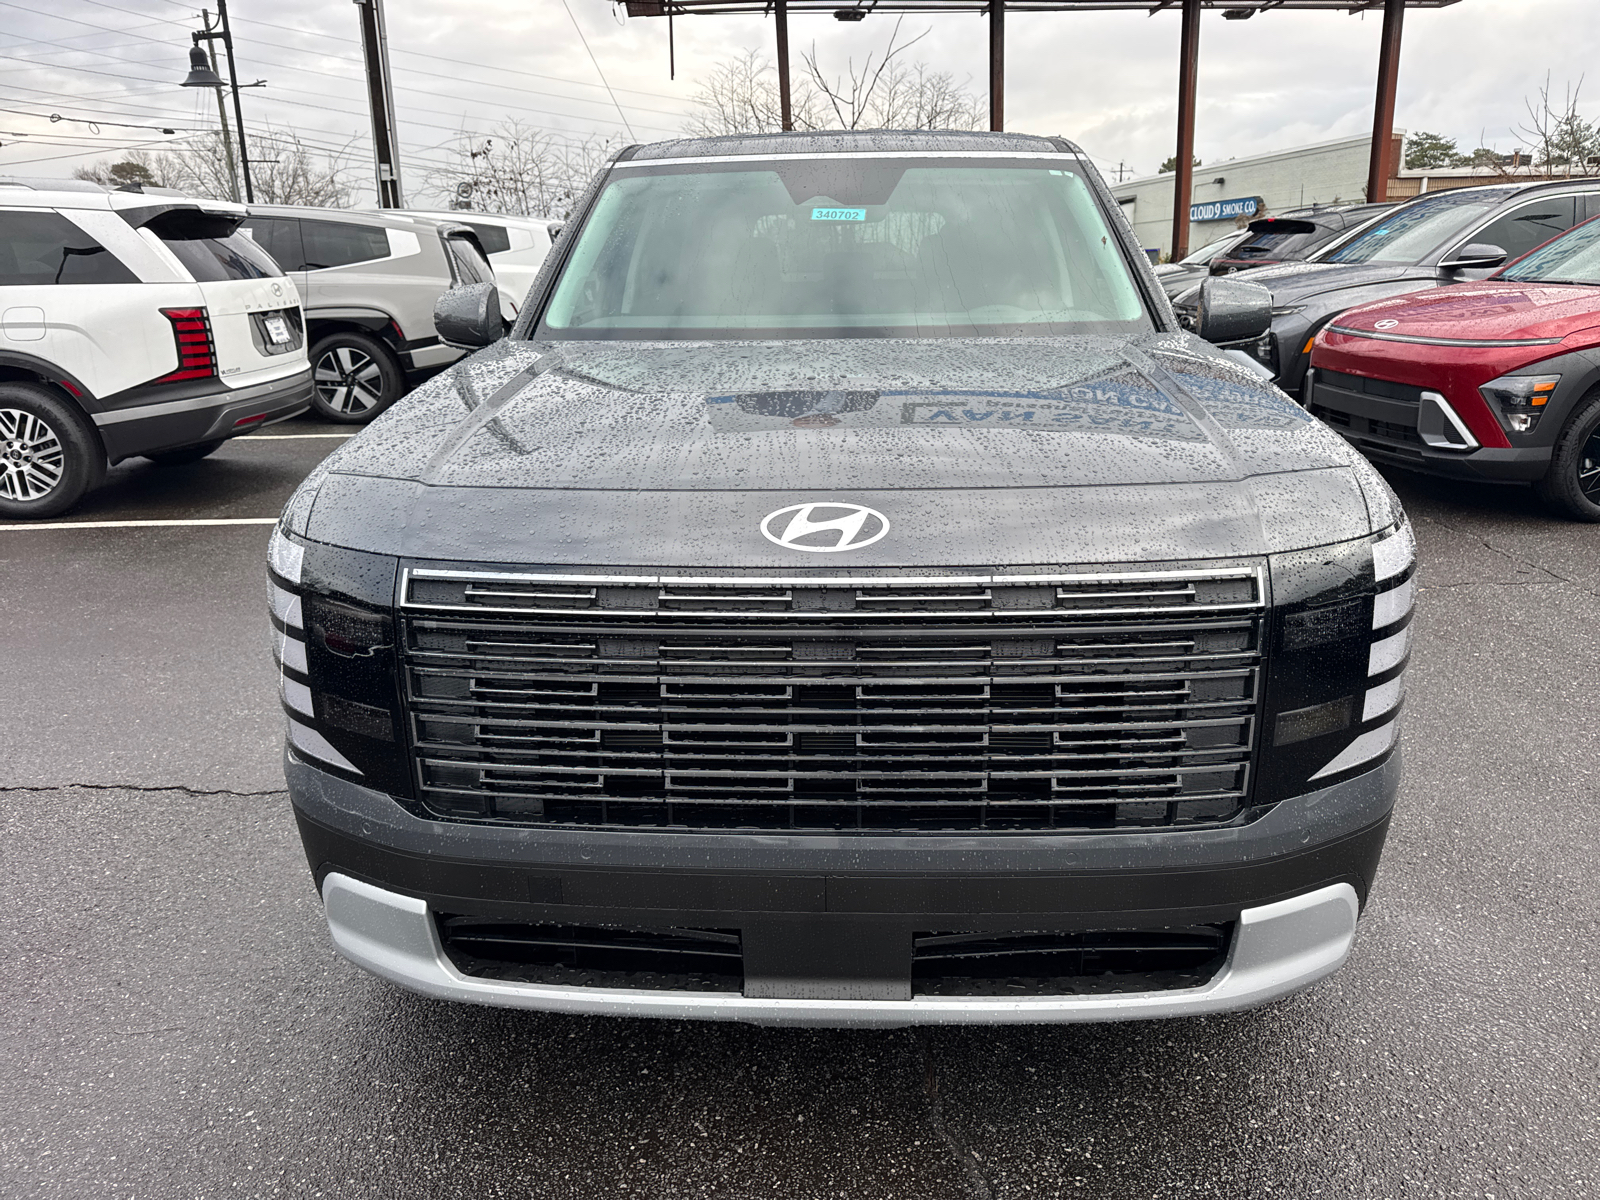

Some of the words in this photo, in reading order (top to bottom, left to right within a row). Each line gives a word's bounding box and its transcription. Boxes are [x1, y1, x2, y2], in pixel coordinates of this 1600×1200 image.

[815, 210, 860, 220] 340702
[1190, 205, 1214, 220] CLOUD
[1214, 203, 1221, 218] 9
[1222, 202, 1243, 215] SMOKE
[1244, 200, 1257, 213] CO.
